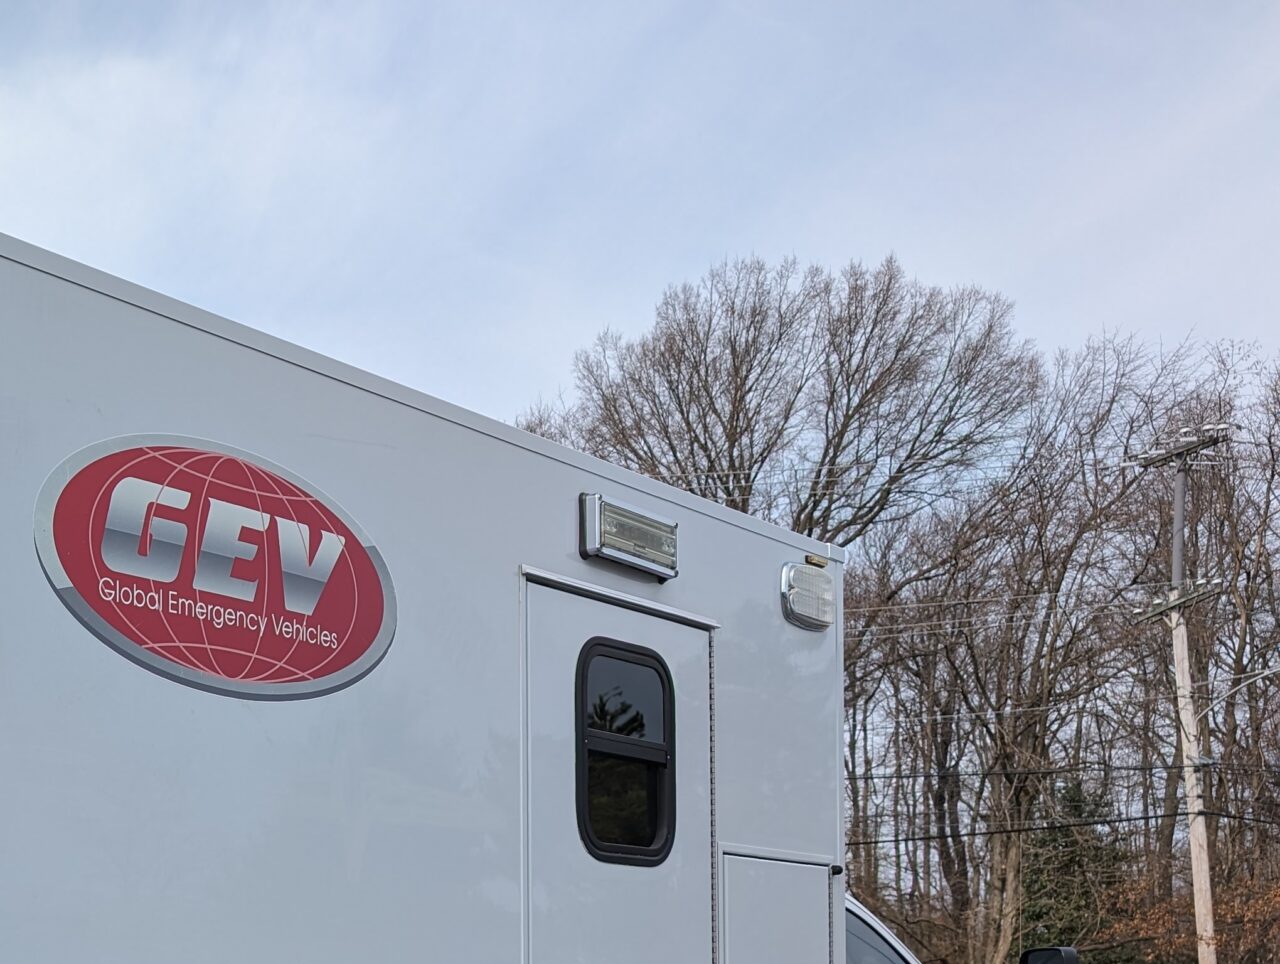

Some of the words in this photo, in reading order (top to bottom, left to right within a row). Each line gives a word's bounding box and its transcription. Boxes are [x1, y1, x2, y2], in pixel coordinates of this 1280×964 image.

[100, 476, 345, 616] GEV
[98, 577, 163, 611] Global
[168, 591, 267, 637] Emergency
[271, 613, 338, 649] Vehicles
